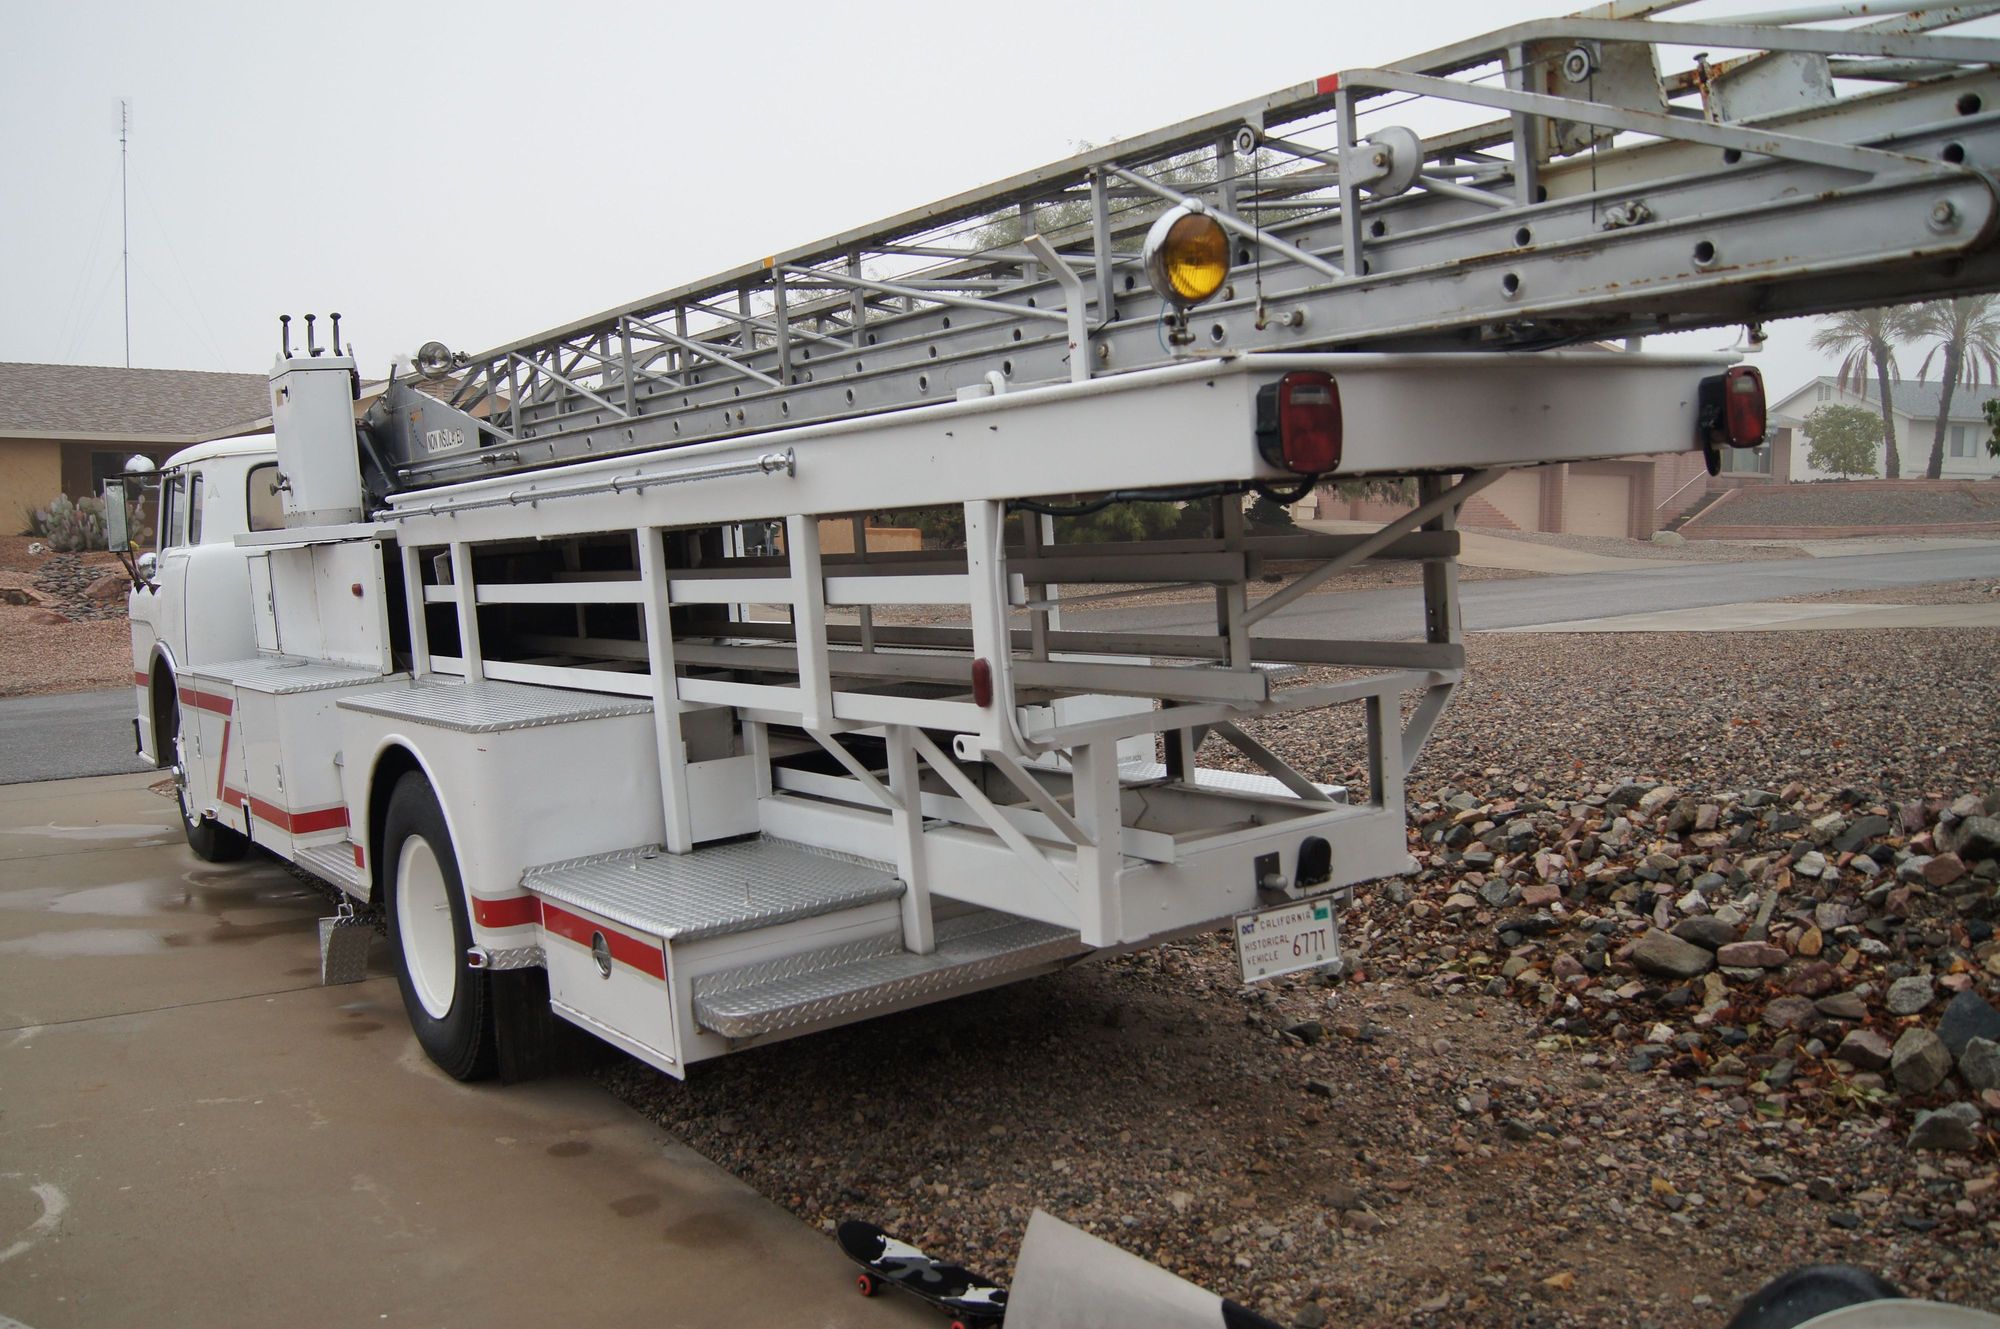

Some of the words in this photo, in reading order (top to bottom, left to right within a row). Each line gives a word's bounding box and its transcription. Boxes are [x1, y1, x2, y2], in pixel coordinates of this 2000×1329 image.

[427, 432, 439, 450] NON
[1241, 923, 1255, 935] OCT
[1260, 911, 1311, 930] CALIFORNIA
[1244, 934, 1290, 952] HISTORICAL
[1293, 928, 1326, 957] 677T
[1247, 951, 1279, 965] VEHICLE
